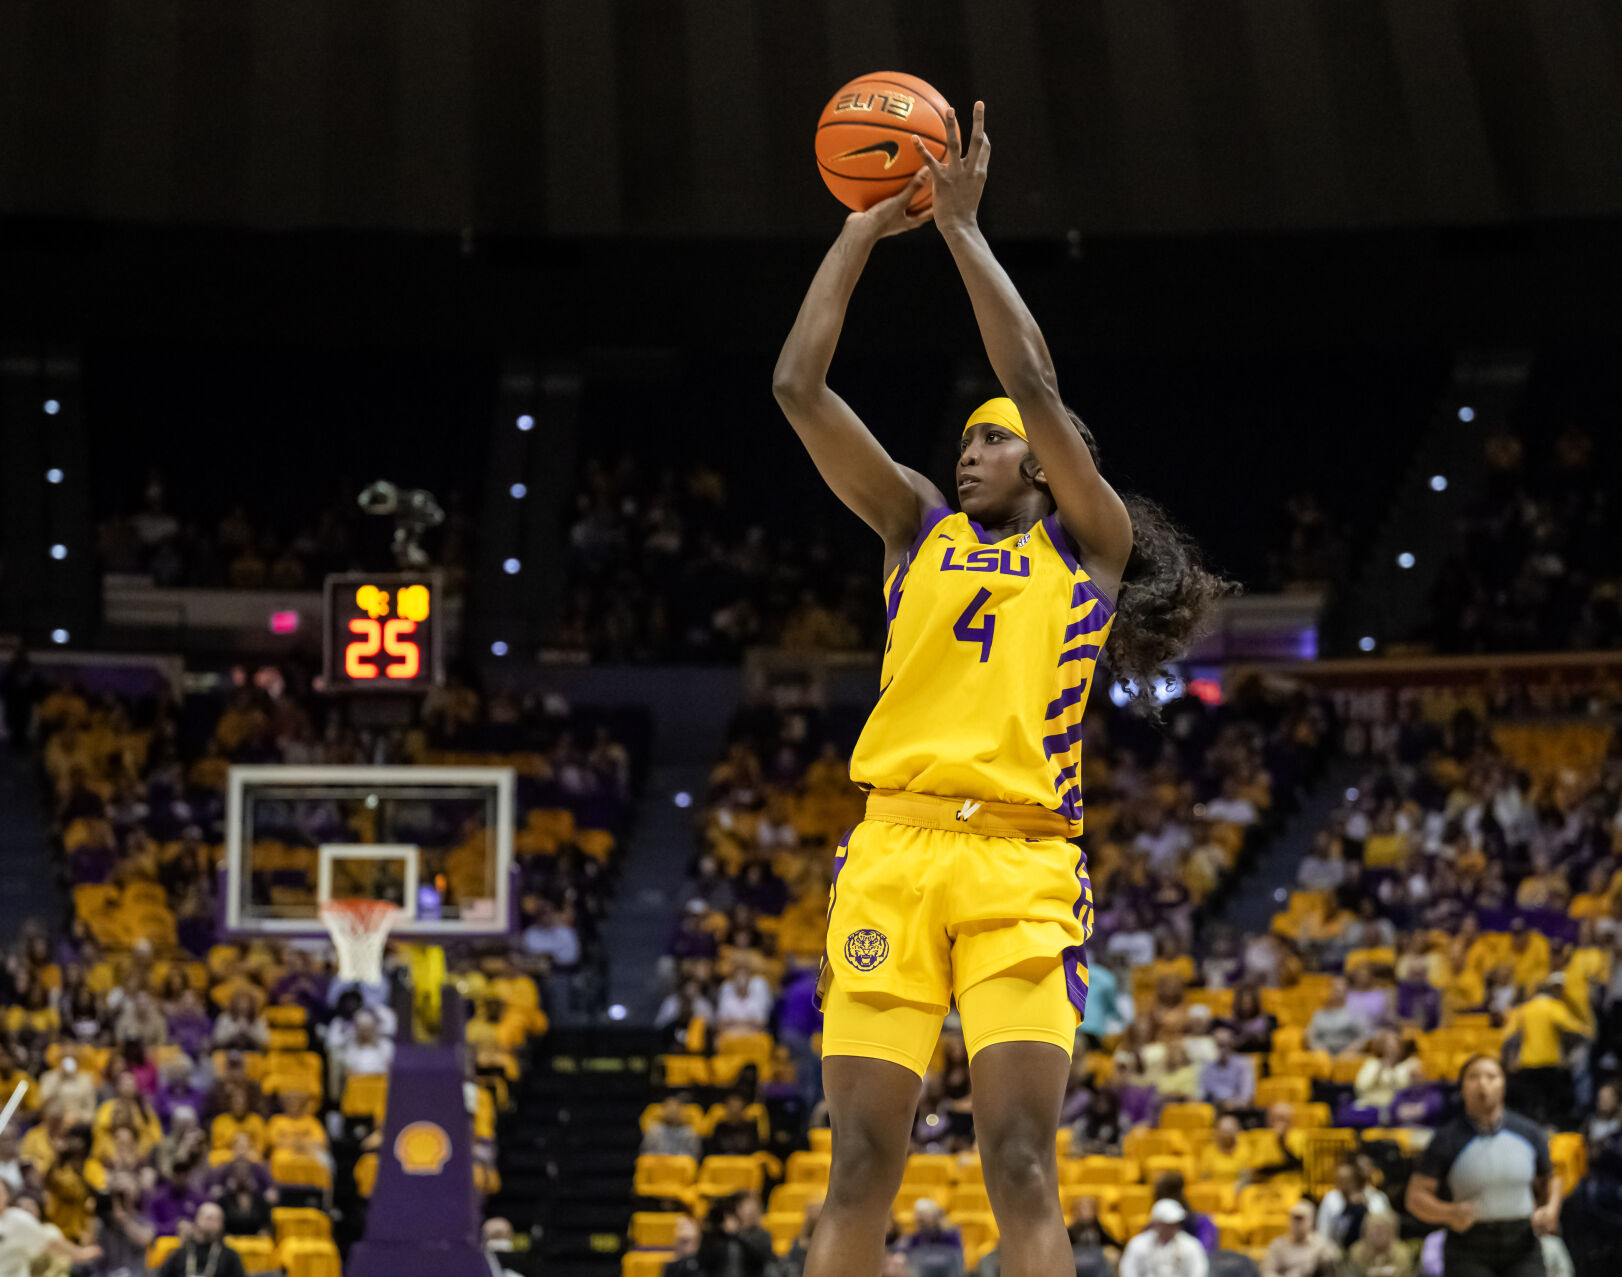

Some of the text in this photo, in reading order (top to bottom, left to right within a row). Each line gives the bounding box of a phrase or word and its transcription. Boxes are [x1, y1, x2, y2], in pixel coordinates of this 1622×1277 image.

[940, 547, 1030, 577] LSU
[345, 618, 420, 679] 25
[953, 586, 996, 663] 4
